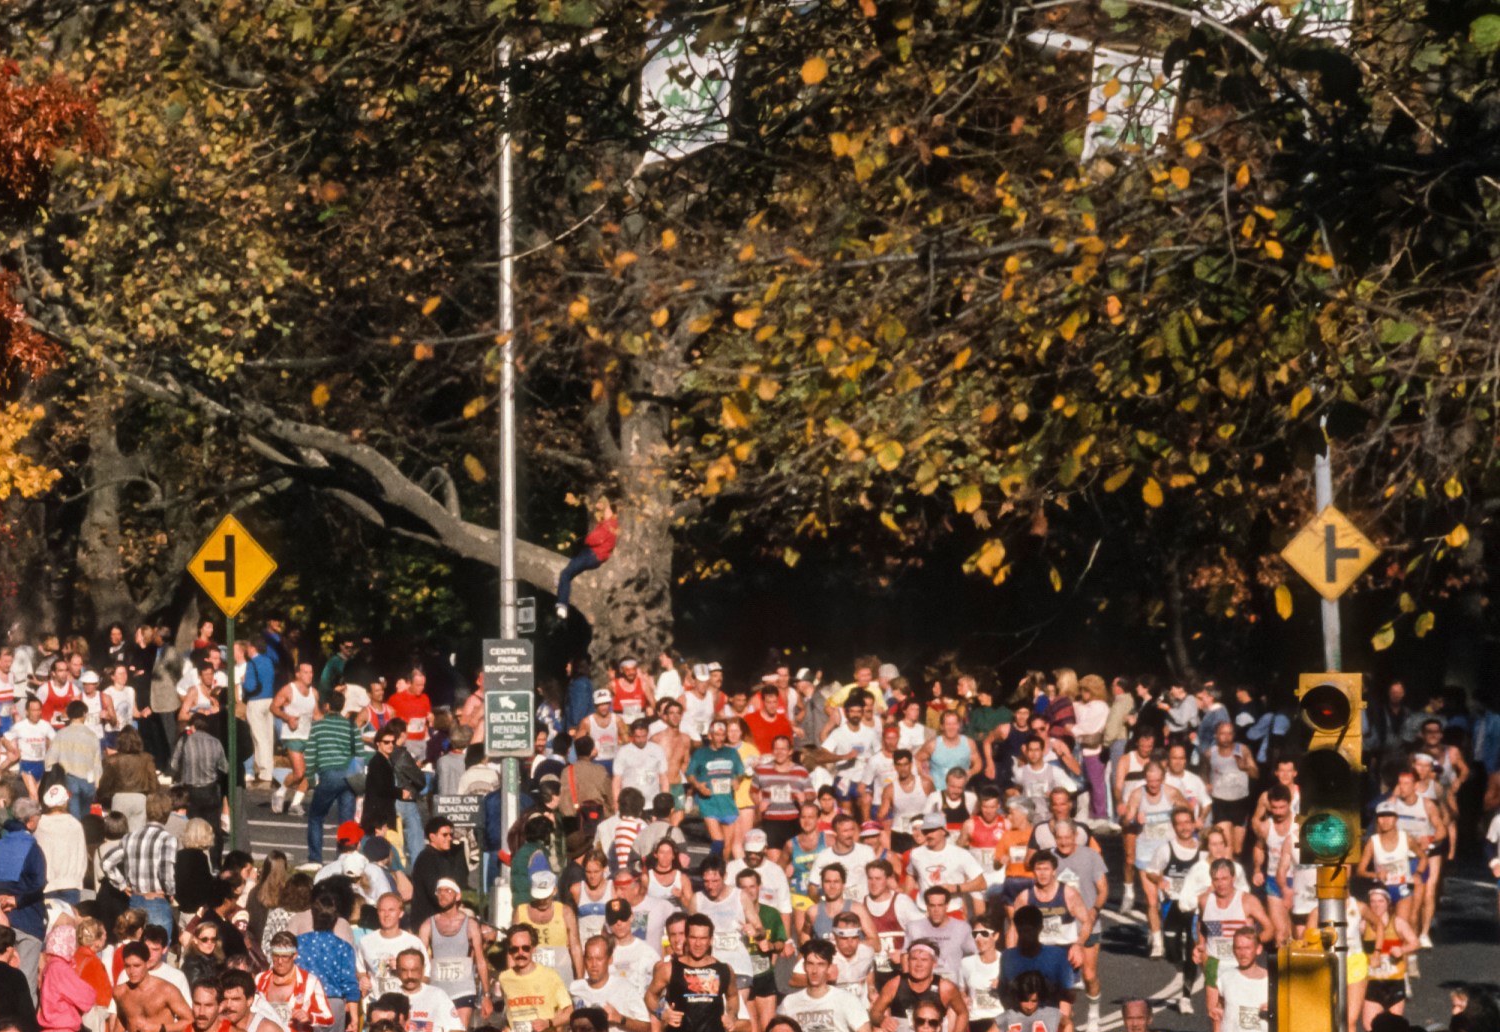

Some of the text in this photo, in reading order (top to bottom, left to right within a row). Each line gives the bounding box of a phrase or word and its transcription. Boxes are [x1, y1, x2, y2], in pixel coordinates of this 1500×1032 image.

[489, 647, 527, 656] CENTRAL
[497, 656, 519, 664] PARK
[484, 664, 533, 673] BOATHOUSE
[489, 711, 529, 723] BICYCLES
[492, 725, 526, 735] RENTALS
[491, 739, 528, 750] REPAIRS
[463, 796, 478, 804] ON
[437, 805, 480, 814] ROADWAY
[446, 814, 470, 822] ONLY
